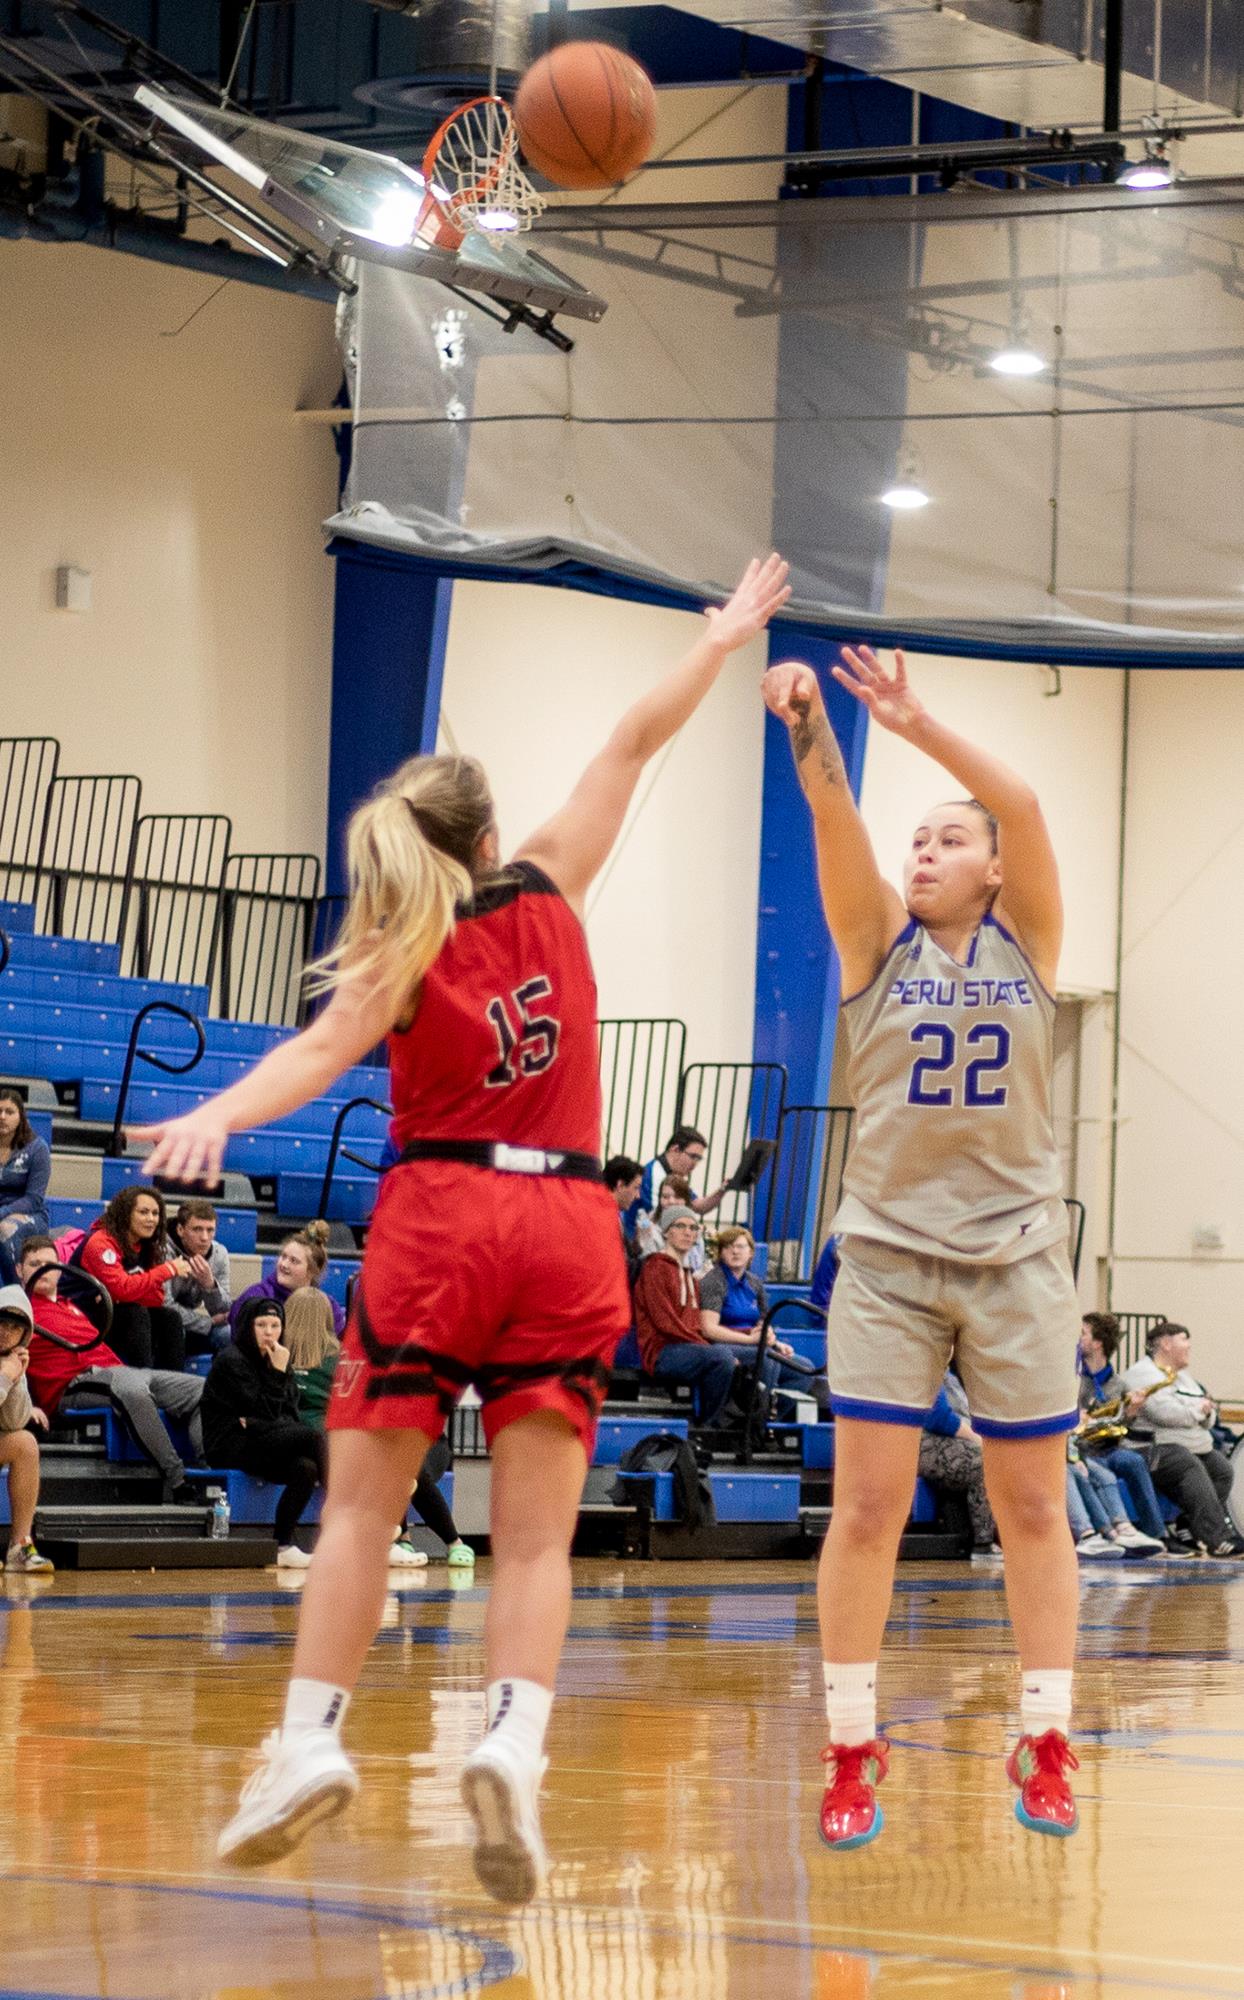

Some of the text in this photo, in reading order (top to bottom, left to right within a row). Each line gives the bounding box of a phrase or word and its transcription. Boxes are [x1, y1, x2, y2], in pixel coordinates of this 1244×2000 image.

[484, 974, 562, 1088] 15
[889, 977, 1034, 1008] PERU STATE
[906, 1021, 1011, 1108] 22
